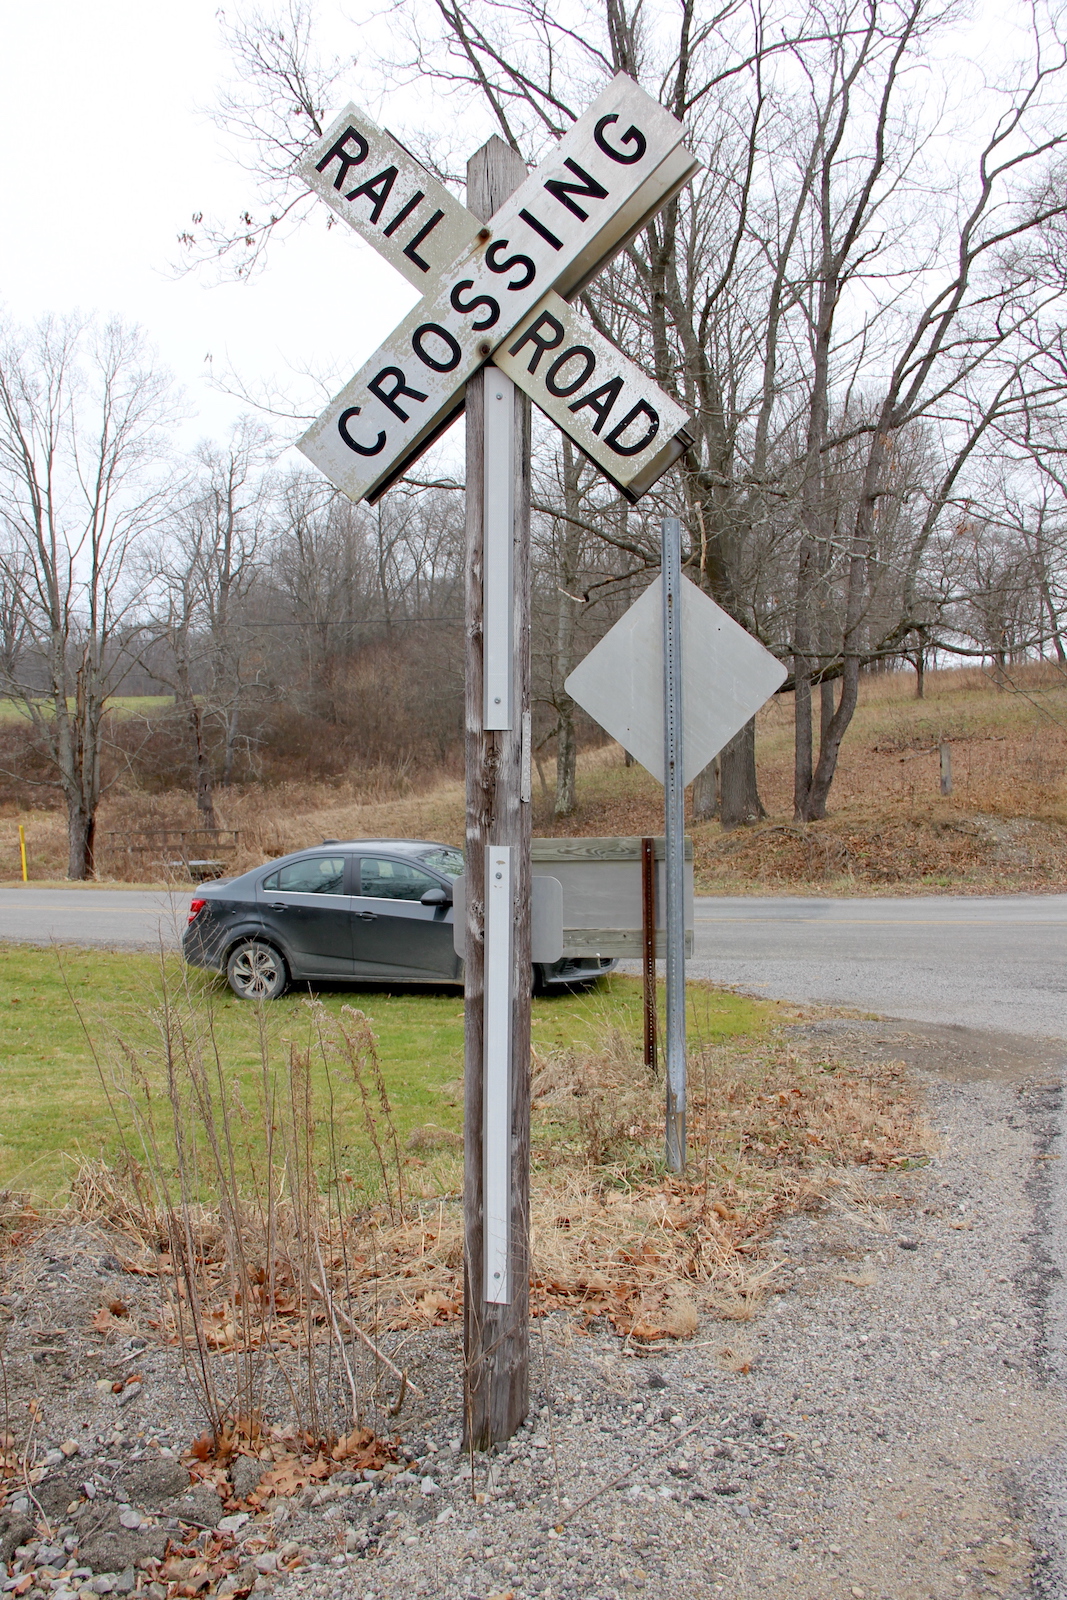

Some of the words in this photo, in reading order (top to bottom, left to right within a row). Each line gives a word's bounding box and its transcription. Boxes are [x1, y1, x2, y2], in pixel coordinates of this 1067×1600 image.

[314, 125, 446, 274] RAIL
[507, 309, 660, 457] ROAD
[337, 113, 647, 457] CROSSING
